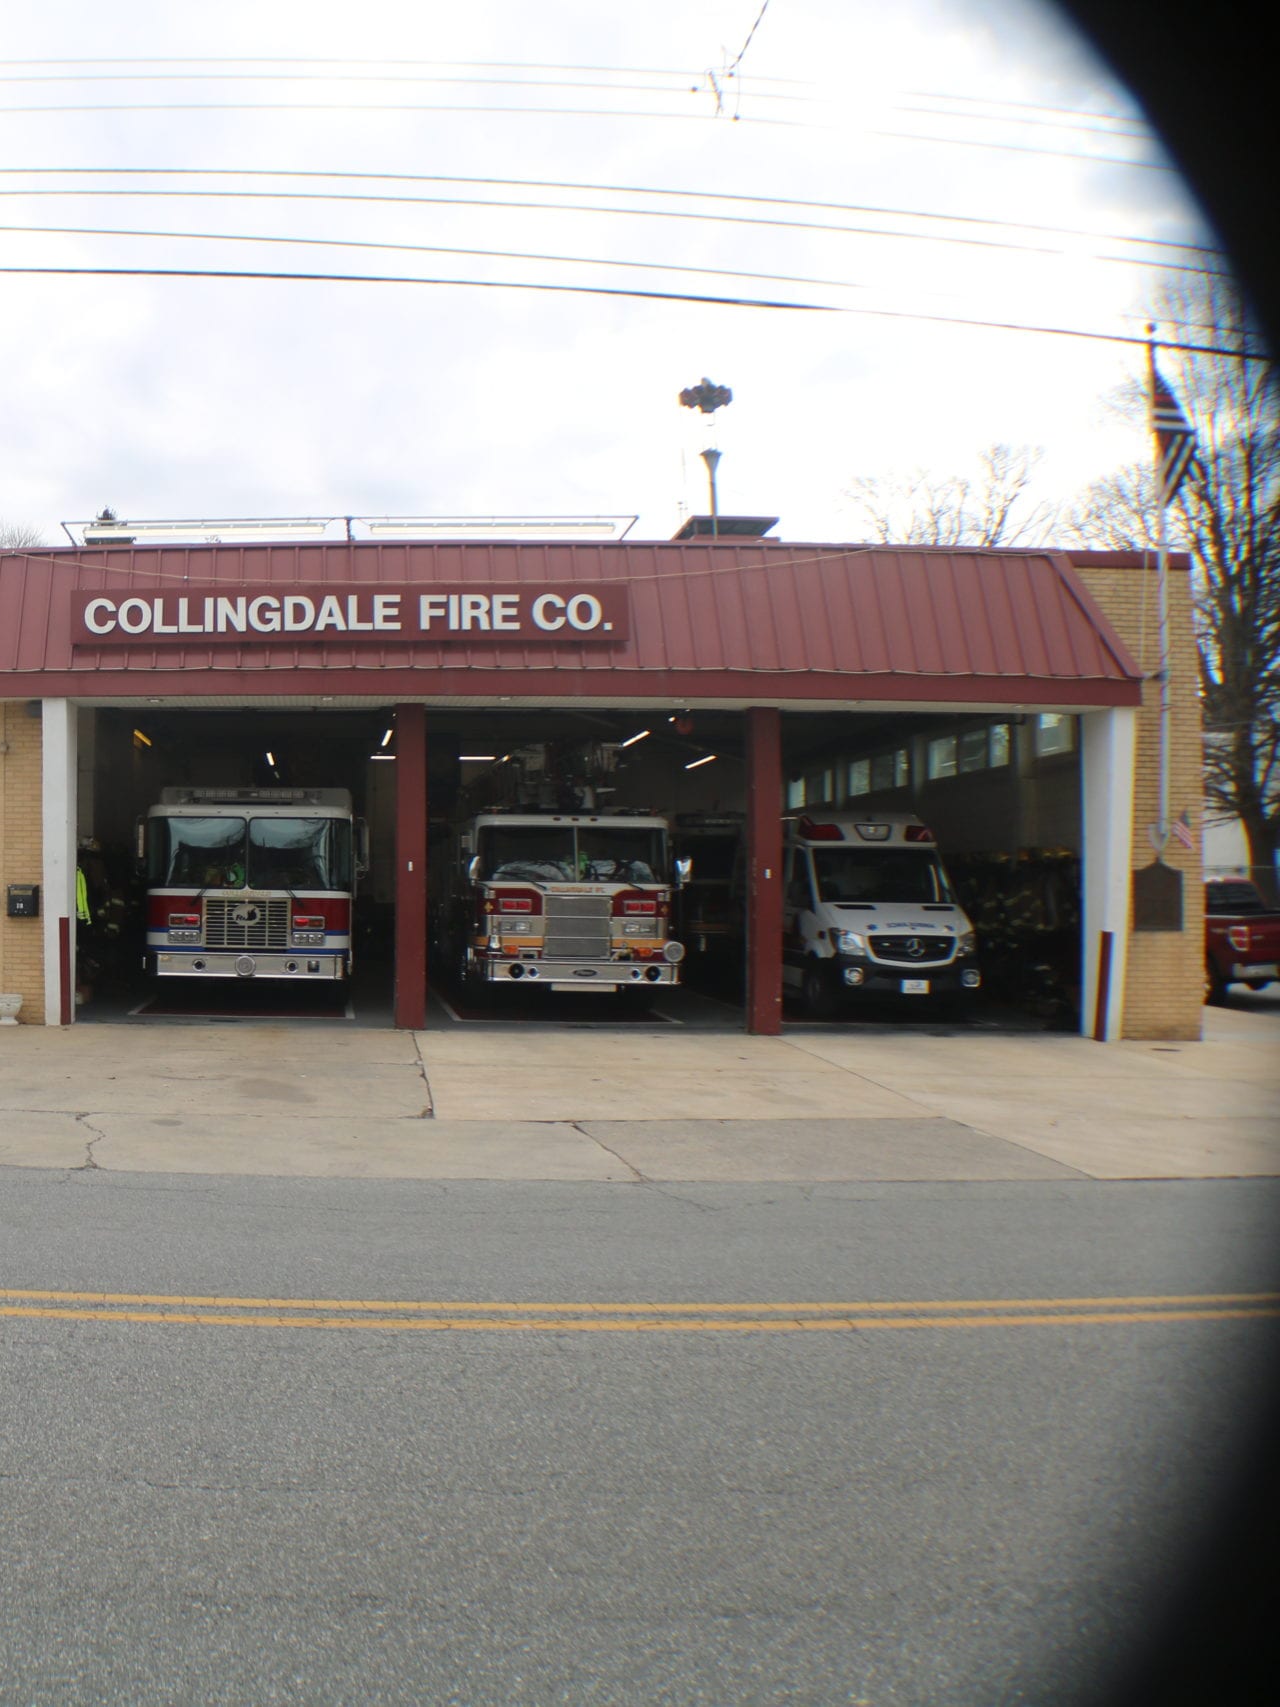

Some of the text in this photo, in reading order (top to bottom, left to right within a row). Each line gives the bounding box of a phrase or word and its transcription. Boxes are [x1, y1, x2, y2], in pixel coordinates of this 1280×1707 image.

[84, 593, 613, 634] COLLINGDALE FIRE CO.
